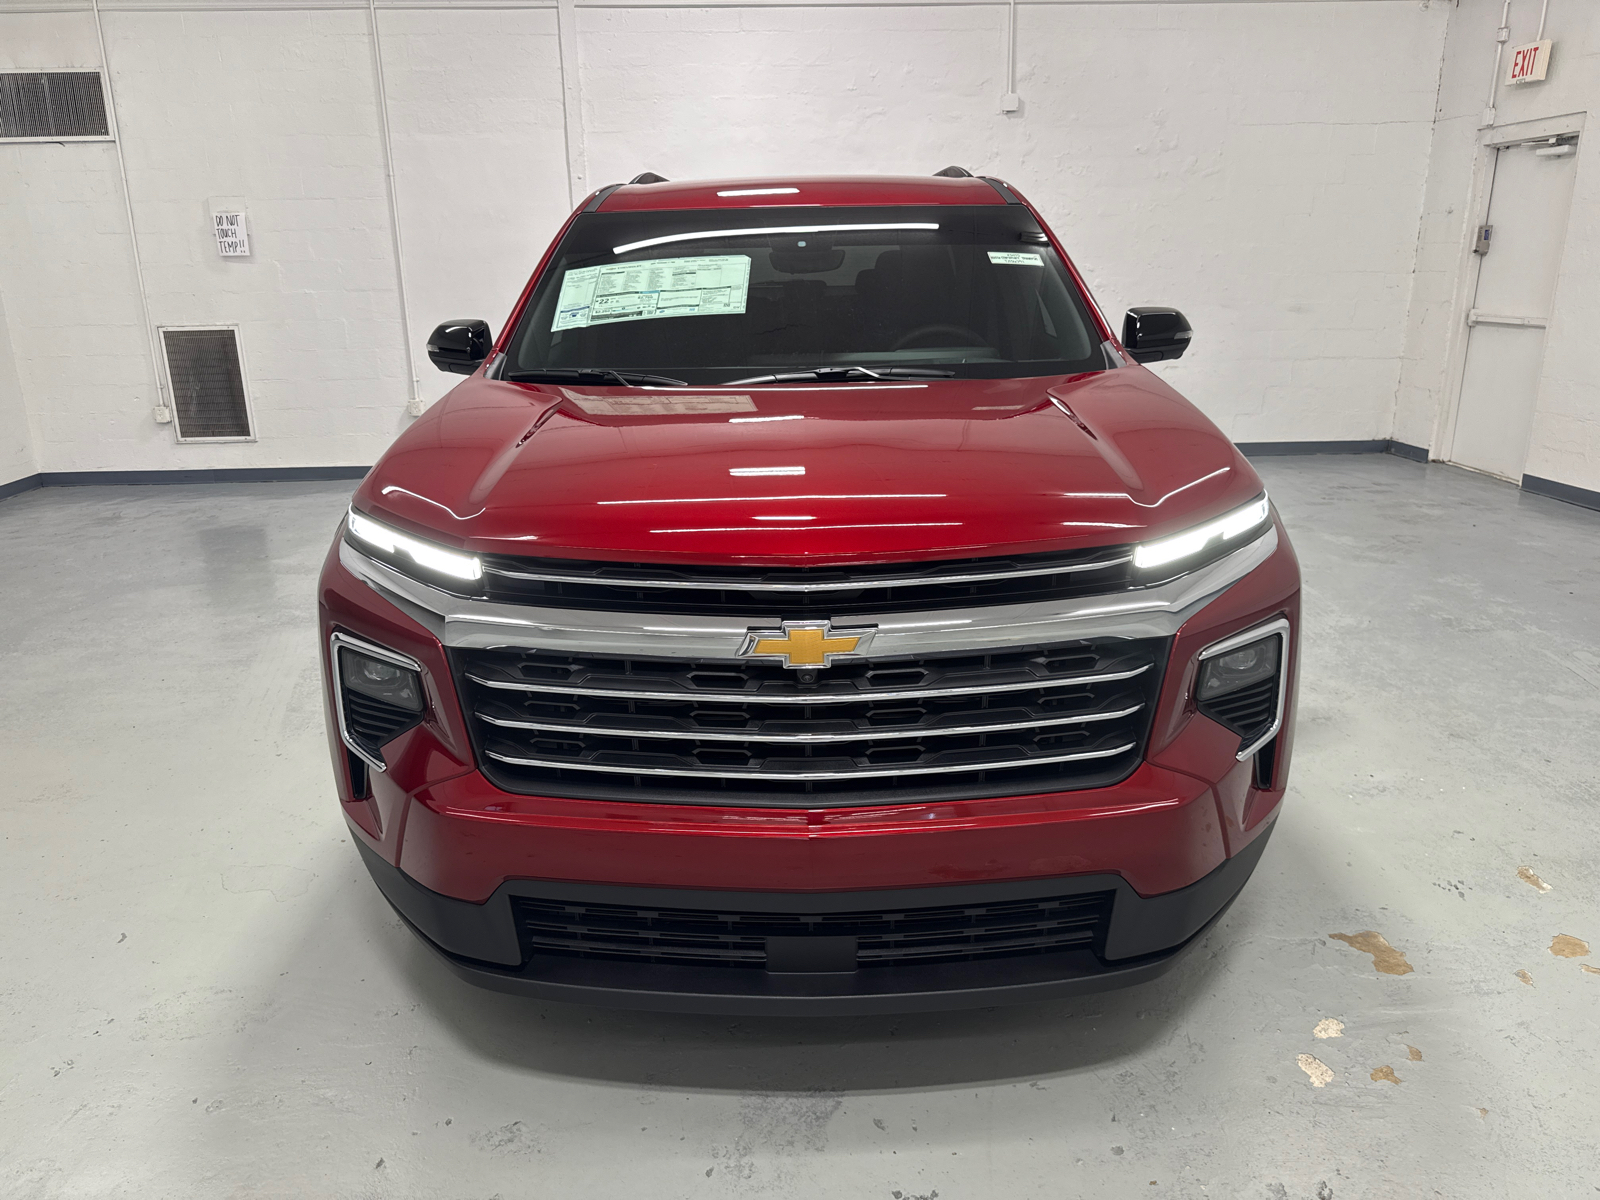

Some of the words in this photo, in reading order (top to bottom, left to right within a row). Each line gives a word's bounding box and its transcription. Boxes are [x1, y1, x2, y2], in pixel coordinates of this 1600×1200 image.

[1511, 46, 1539, 79] EXIT
[215, 215, 224, 227] DO
[226, 214, 240, 227] NOT
[216, 228, 237, 240] TOUCH
[218, 239, 246, 254] TEMP!!
